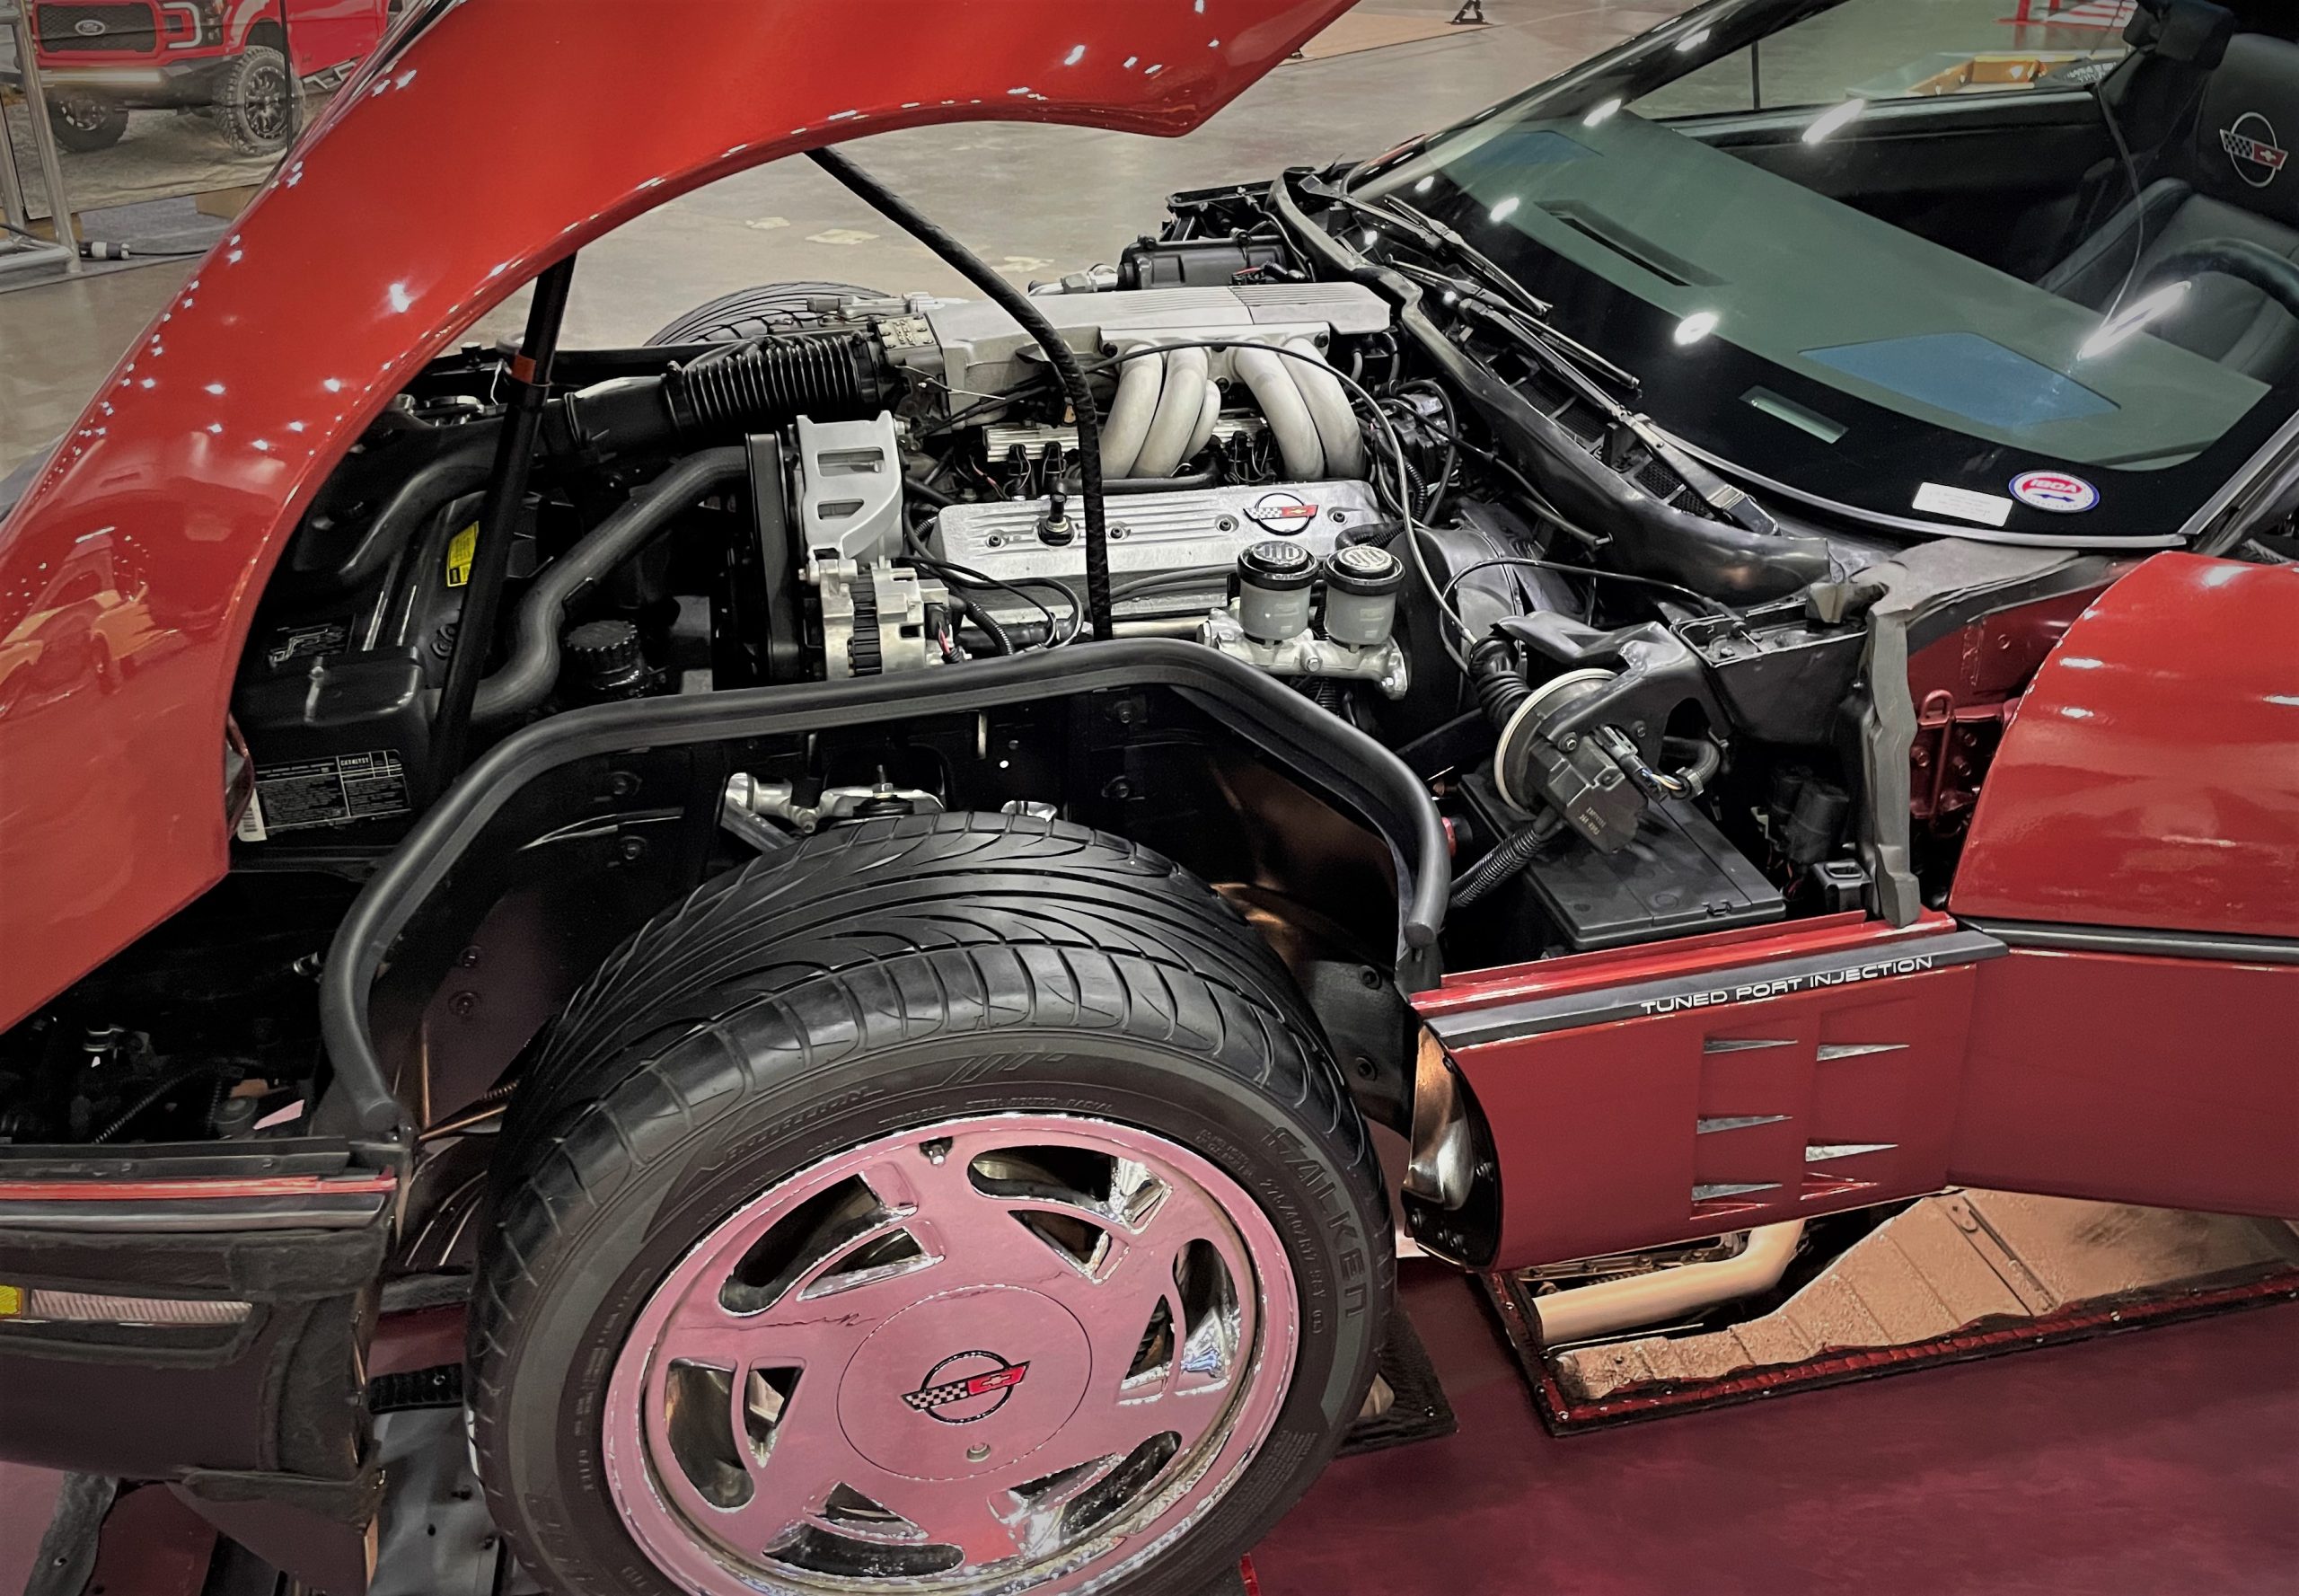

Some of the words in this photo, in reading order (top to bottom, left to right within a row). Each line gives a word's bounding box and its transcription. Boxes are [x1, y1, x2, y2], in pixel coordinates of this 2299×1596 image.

[1641, 991, 1728, 1015] TUNED
[1735, 977, 1803, 1001] PORT
[1810, 956, 1933, 988] INJECTION
[1261, 1125, 1368, 1318] FALKEN
